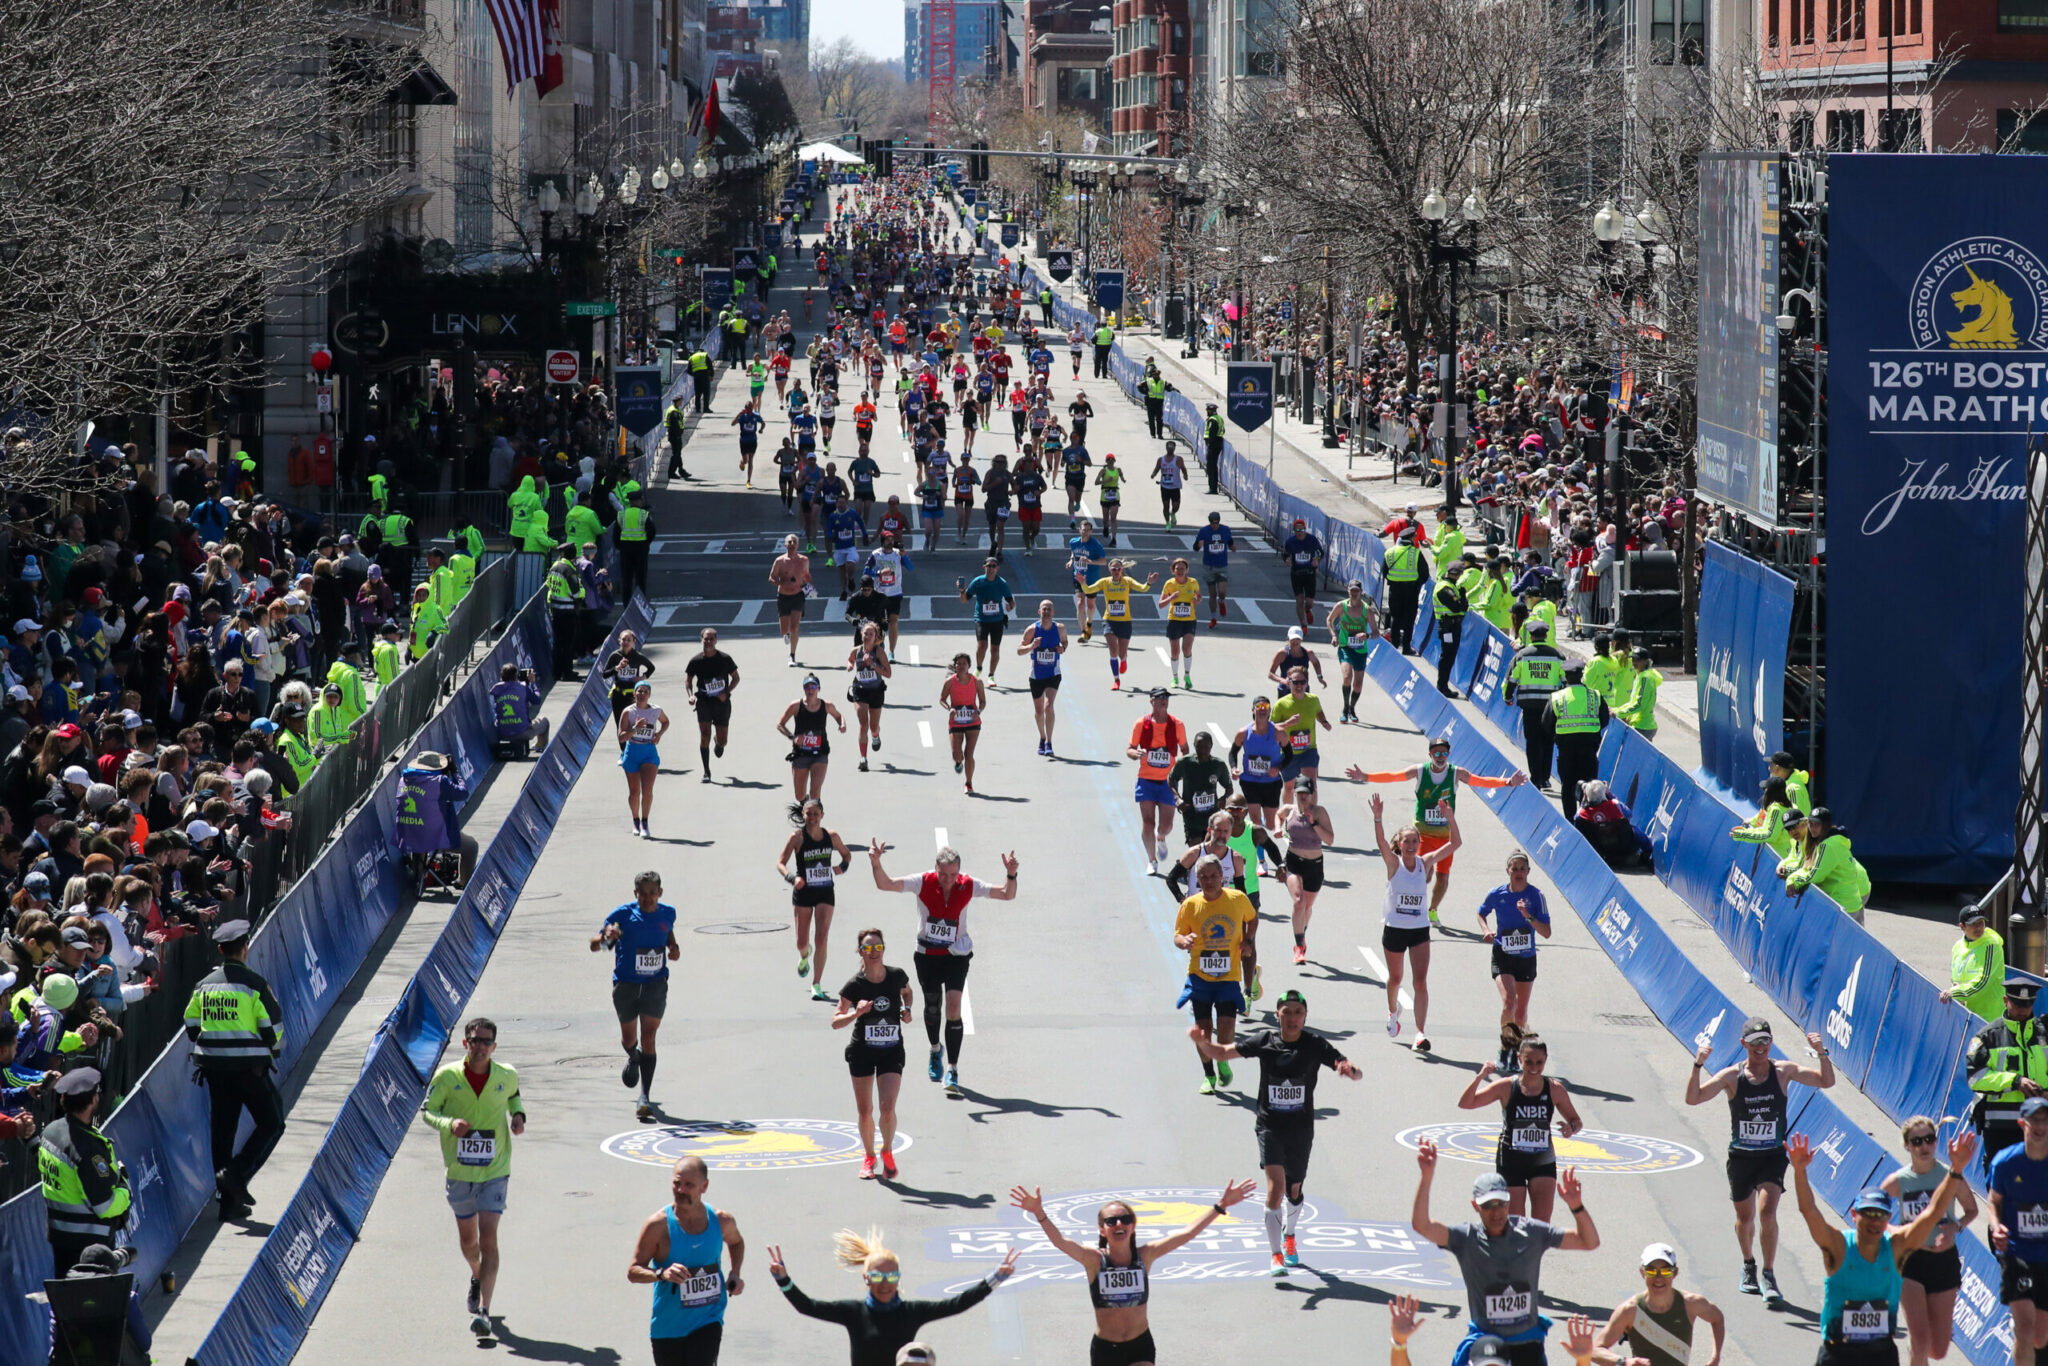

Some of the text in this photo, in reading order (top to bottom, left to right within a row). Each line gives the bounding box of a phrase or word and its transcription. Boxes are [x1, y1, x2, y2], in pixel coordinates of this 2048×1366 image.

[1916, 275, 1937, 343] BOSTON
[1933, 242, 2003, 279] ATHLETIC
[577, 304, 603, 315] EXETER
[1869, 361, 2048, 389] 126TH BOST
[1860, 456, 1956, 535] John
[1528, 662, 1551, 671] BOSTON
[1530, 670, 1549, 679] POLICE
[400, 785, 427, 797] BOSTON
[400, 816, 425, 826] MEDIA
[1400, 895, 1422, 906] 15397
[930, 923, 952, 938] 9794
[1505, 936, 1529, 948] 13489
[1203, 958, 1227, 969] 10421
[202, 991, 238, 1008] Boston
[202, 1008, 239, 1021] Police
[869, 1025, 897, 1037] 15357
[1826, 1008, 1853, 1050] adidas
[1272, 1087, 1302, 1100] 13809
[1515, 1105, 1548, 1119] NBR
[1748, 1106, 1771, 1114] MARK
[1517, 1129, 1546, 1143] 14004
[1744, 1122, 1773, 1136] 15772
[461, 1139, 493, 1153] 12576
[2022, 1213, 2048, 1228] 1449
[1135, 1224, 1409, 1240] BOSON
[951, 1238, 1415, 1254] MATHON
[686, 1276, 719, 1294] 10624
[1104, 1272, 1139, 1288] 13901
[1851, 1313, 1881, 1328] 8939
